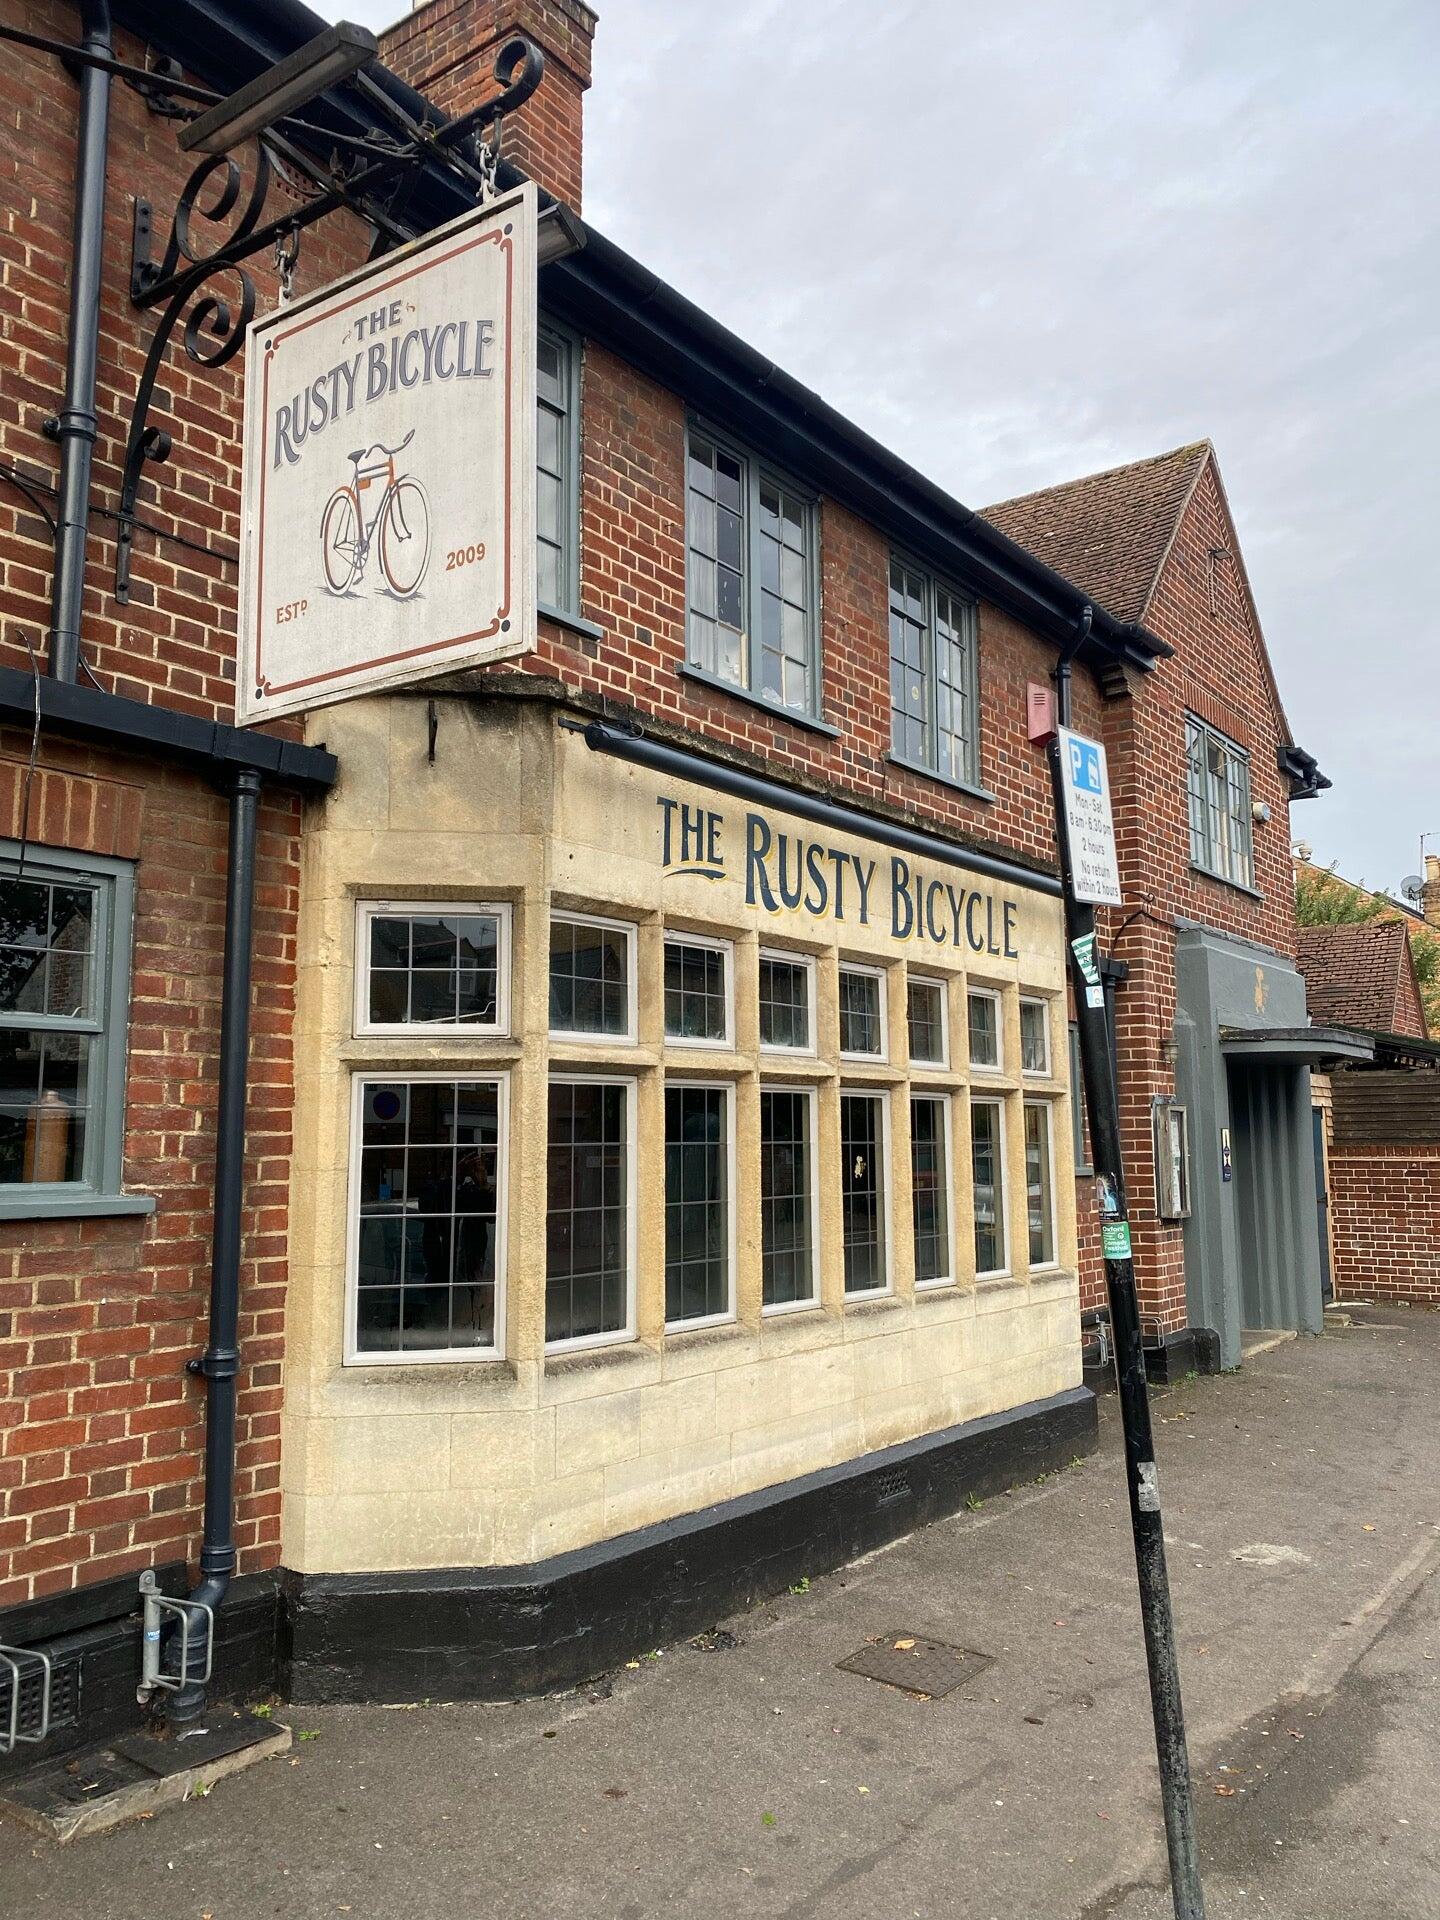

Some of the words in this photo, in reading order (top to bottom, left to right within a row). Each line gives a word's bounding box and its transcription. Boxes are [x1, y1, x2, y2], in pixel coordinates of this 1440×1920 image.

[353, 300, 402, 341] THE
[273, 352, 363, 470] RUSTY
[365, 319, 494, 403] BICYCLE
[445, 542, 486, 571] 2009
[1070, 743, 1082, 782] P
[1082, 837, 1088, 851] 2
[1088, 838, 1105, 856] hours
[657, 795, 725, 867] THE
[745, 812, 877, 925] RUSTY
[890, 855, 1019, 959] BICYCLE
[1081, 859, 1091, 875] No
[1092, 862, 1111, 879] return
[1077, 876, 1096, 894] within
[1096, 880, 1102, 894] 2
[1102, 881, 1119, 898] hours
